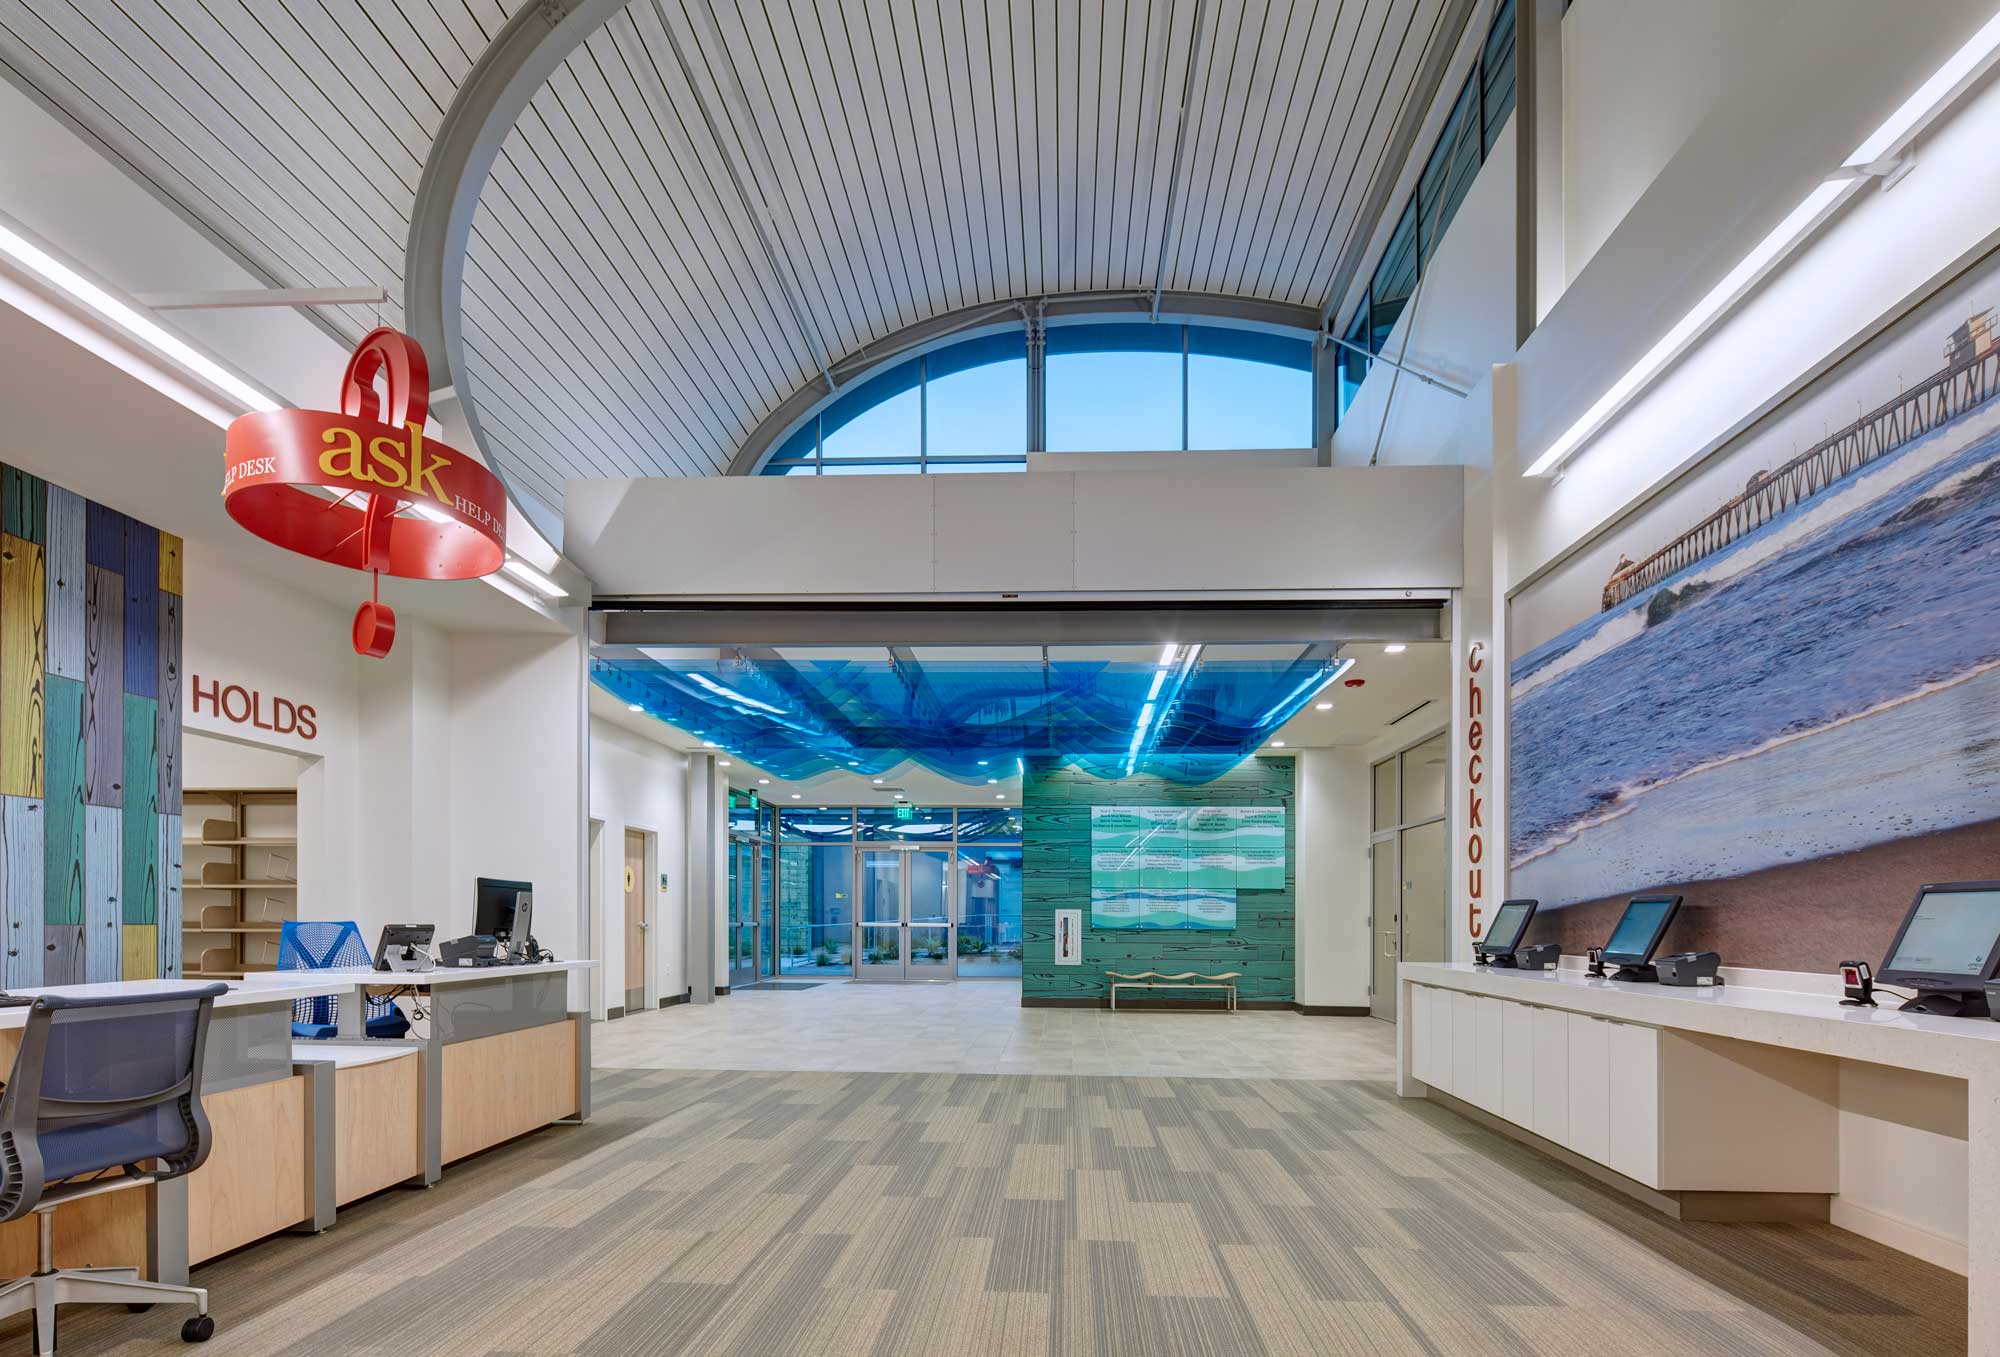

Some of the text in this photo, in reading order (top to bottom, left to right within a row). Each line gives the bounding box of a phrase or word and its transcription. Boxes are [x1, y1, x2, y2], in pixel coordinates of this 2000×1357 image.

[238, 457, 276, 479] DESK
[319, 420, 454, 506] ask
[455, 494, 491, 526] HELP
[192, 674, 317, 740] HOLDS
[897, 807, 910, 818] EXIT
[1468, 642, 1483, 938] checkout
